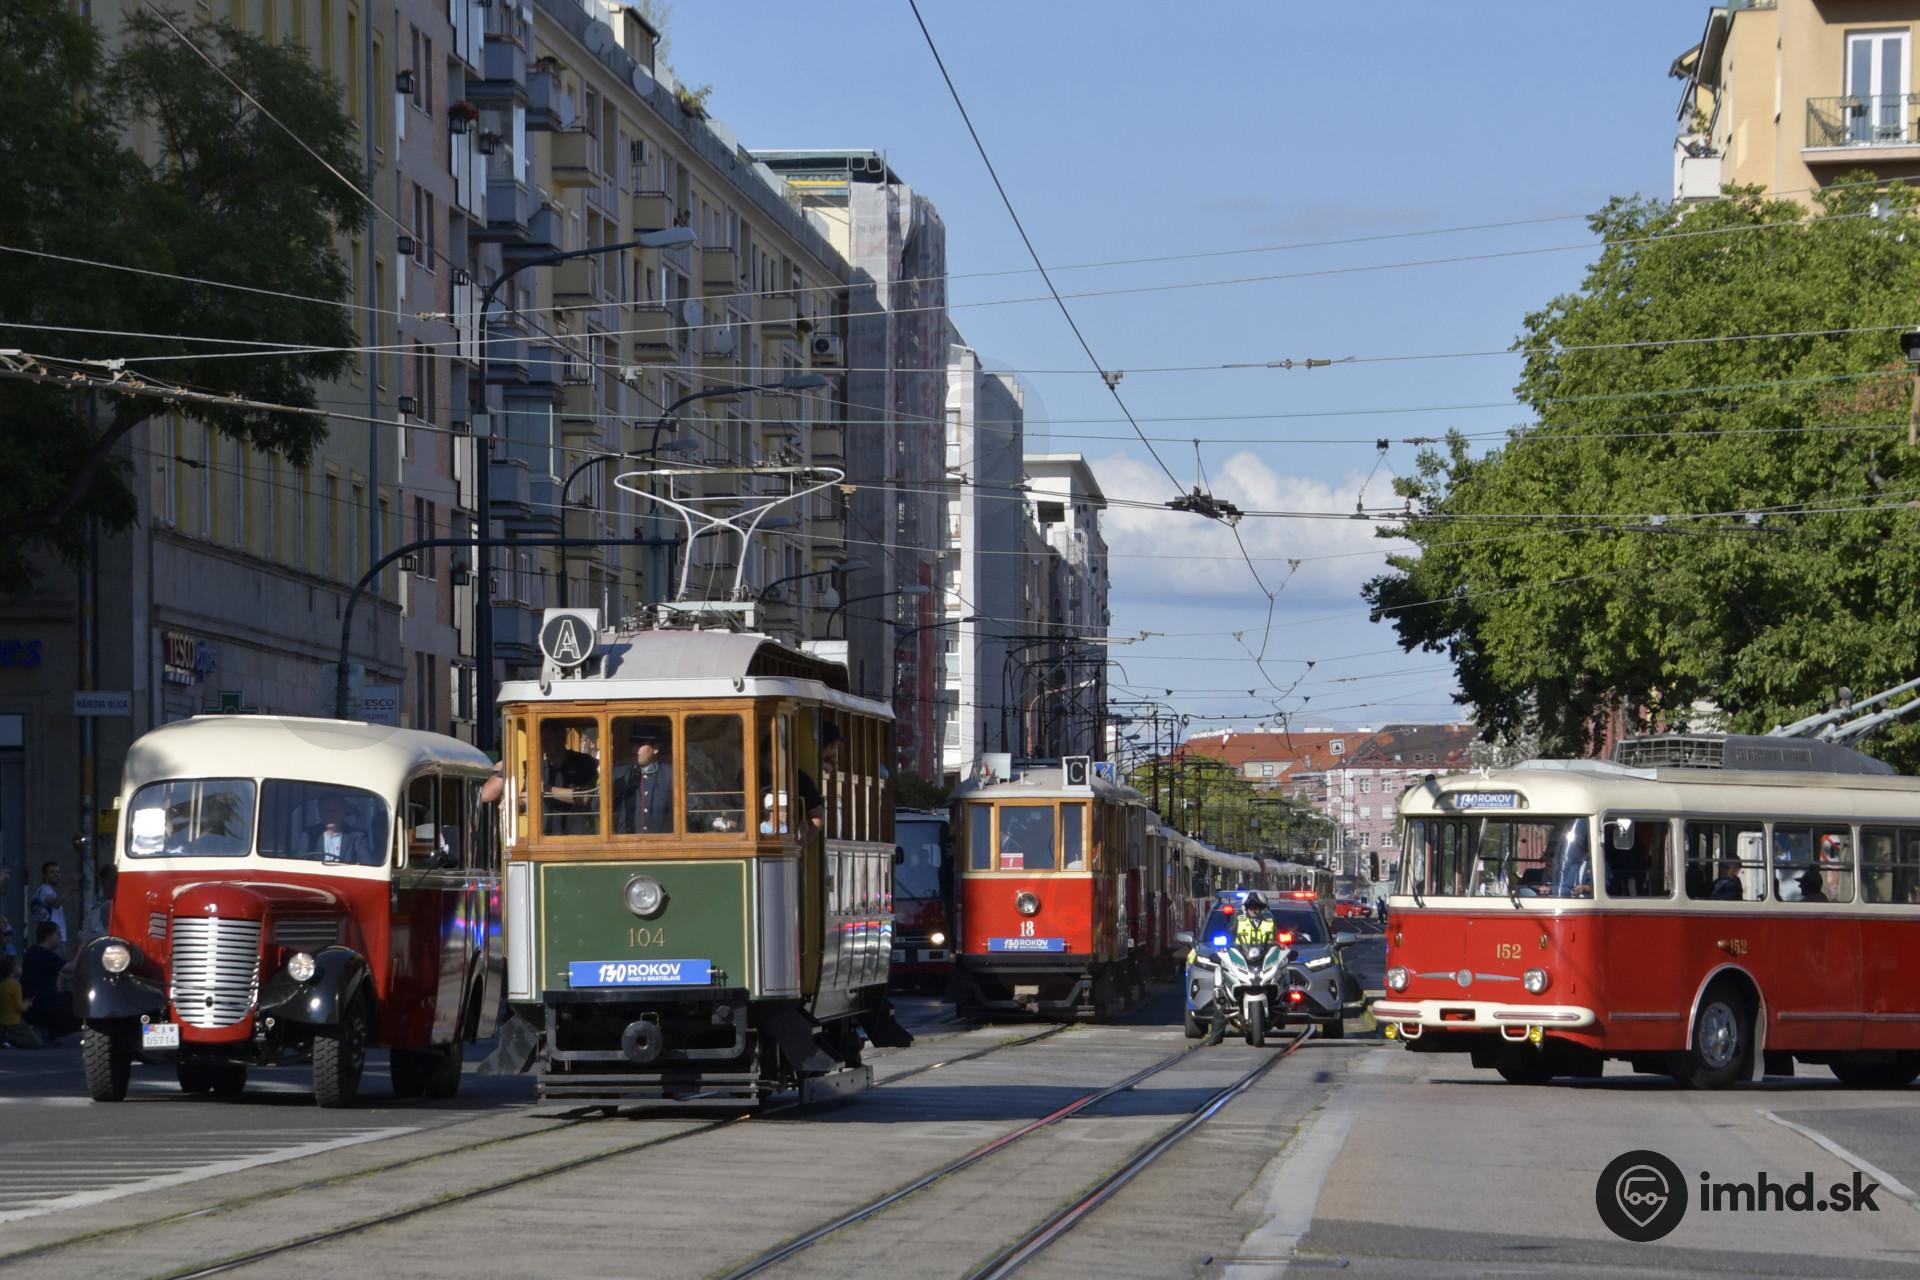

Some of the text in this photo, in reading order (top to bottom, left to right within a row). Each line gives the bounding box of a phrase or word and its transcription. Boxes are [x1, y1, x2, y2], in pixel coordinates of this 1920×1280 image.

[552, 619, 581, 659] A
[168, 631, 195, 670] TESCO
[365, 698, 394, 707] ESCO
[1070, 762, 1083, 782] C
[1460, 794, 1512, 807] 130 ROKOV
[628, 927, 666, 948] 104
[1020, 920, 1035, 937] 18
[1497, 943, 1522, 959] 152
[1730, 939, 1748, 955] 152
[599, 962, 681, 983] 130 ROKOV
